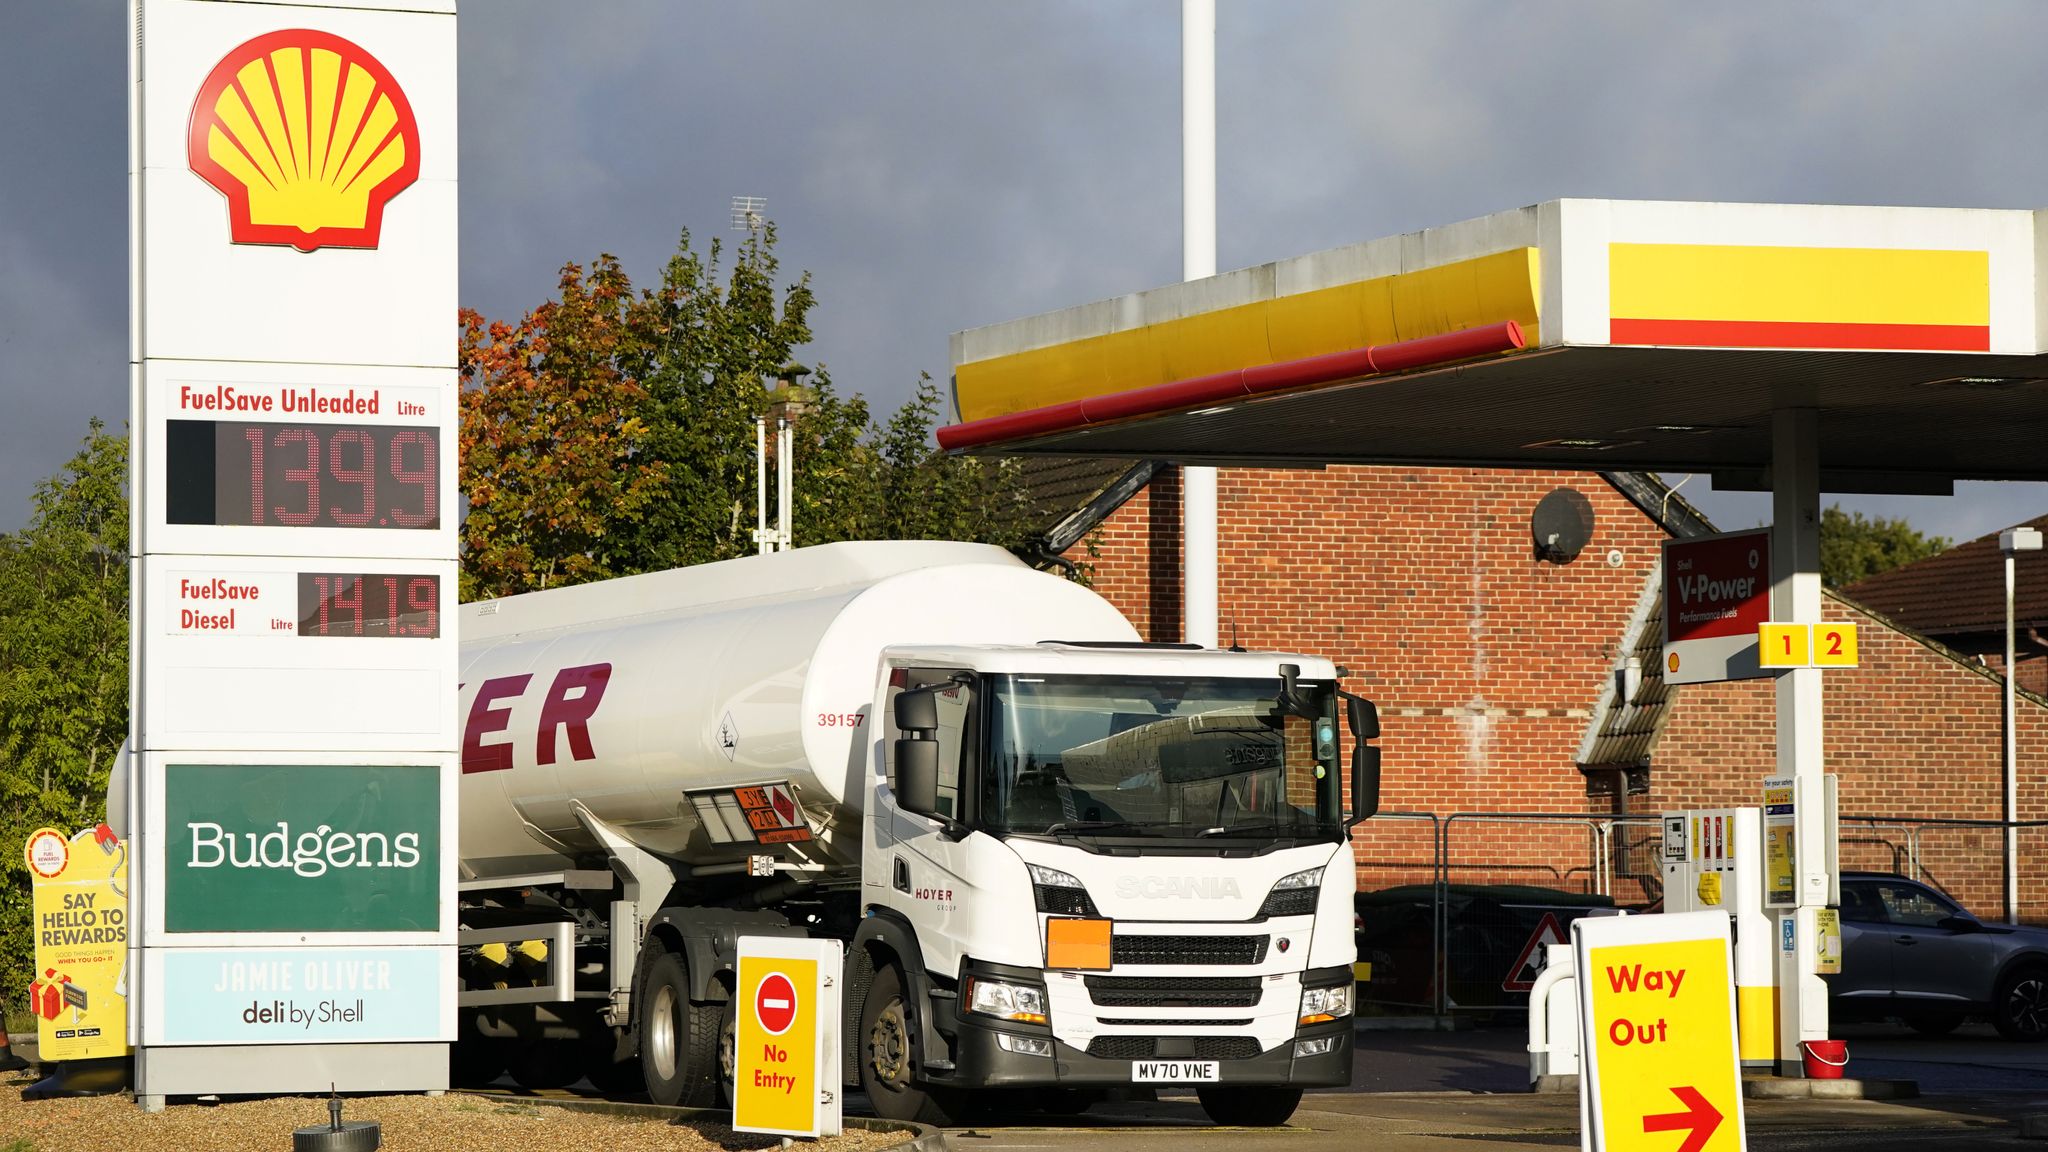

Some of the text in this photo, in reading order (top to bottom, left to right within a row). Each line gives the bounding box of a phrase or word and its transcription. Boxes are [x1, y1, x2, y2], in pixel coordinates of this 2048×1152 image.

[181, 385, 426, 416] FuelSave Unleaded Litre
[246, 428, 437, 526] 139.9
[181, 579, 259, 600] FuelSave
[1677, 574, 1756, 604] V-Power
[314, 577, 437, 635] 141.9
[1679, 608, 1738, 624] Performance Fuels
[181, 608, 293, 630] Diesel Litre
[1782, 635, 1791, 655] 1
[1826, 632, 1842, 655] 2
[458, 662, 612, 775] ER
[817, 713, 865, 728] 39157
[187, 822, 420, 878] Budgens
[916, 888, 953, 901] HOYER
[1114, 875, 1243, 900] SCANIA
[63, 893, 97, 910] SAY
[937, 904, 957, 912] GROUP
[42, 908, 124, 929] HELLO TO
[42, 926, 126, 947] REWARDS
[214, 960, 391, 993] JAMIE OLIVER
[1605, 963, 1686, 998] Way
[242, 998, 364, 1029] deli by Shell
[1609, 1018, 1668, 1047] Out
[764, 1044, 788, 1063] No
[754, 1069, 796, 1095] Entry
[1138, 1064, 1213, 1079] MV70 VNE
